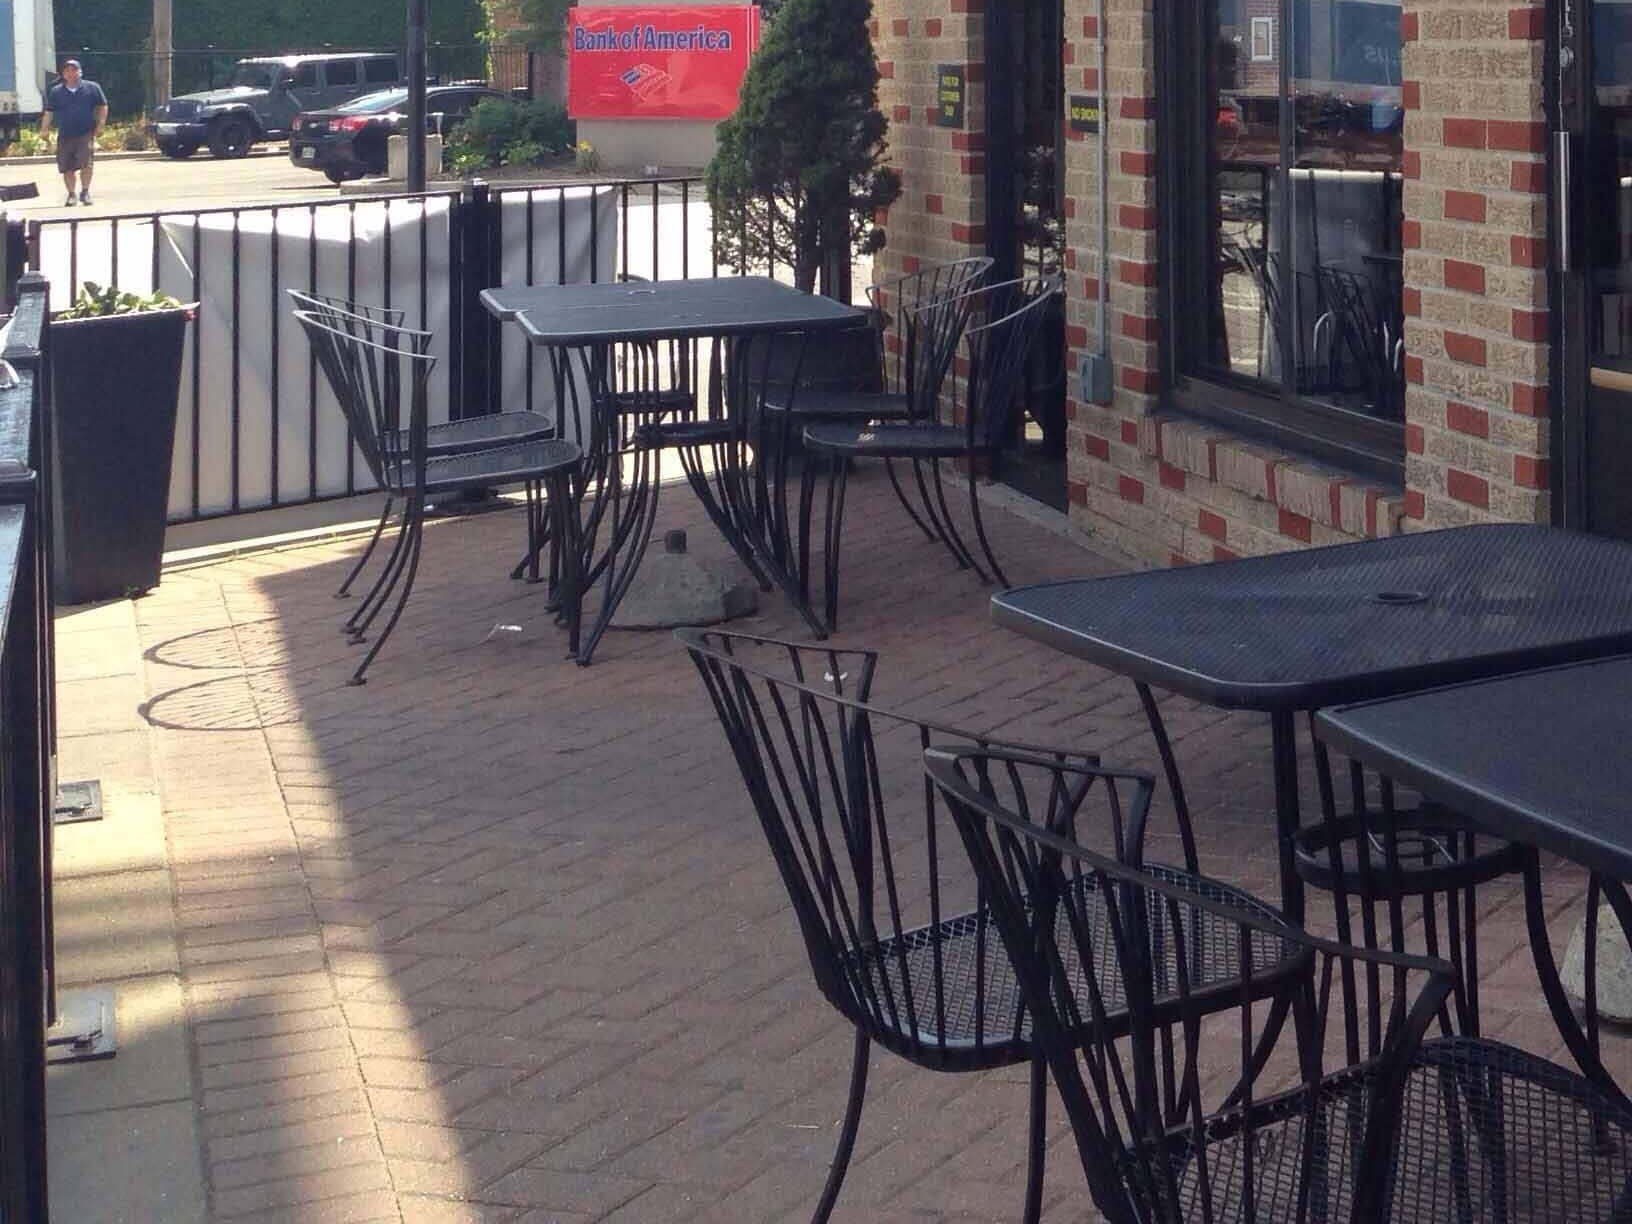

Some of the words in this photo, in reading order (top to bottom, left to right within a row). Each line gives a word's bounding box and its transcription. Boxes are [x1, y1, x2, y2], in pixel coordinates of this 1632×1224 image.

[575, 26, 620, 50] Bank
[621, 25, 642, 50] of
[643, 25, 732, 50] America
